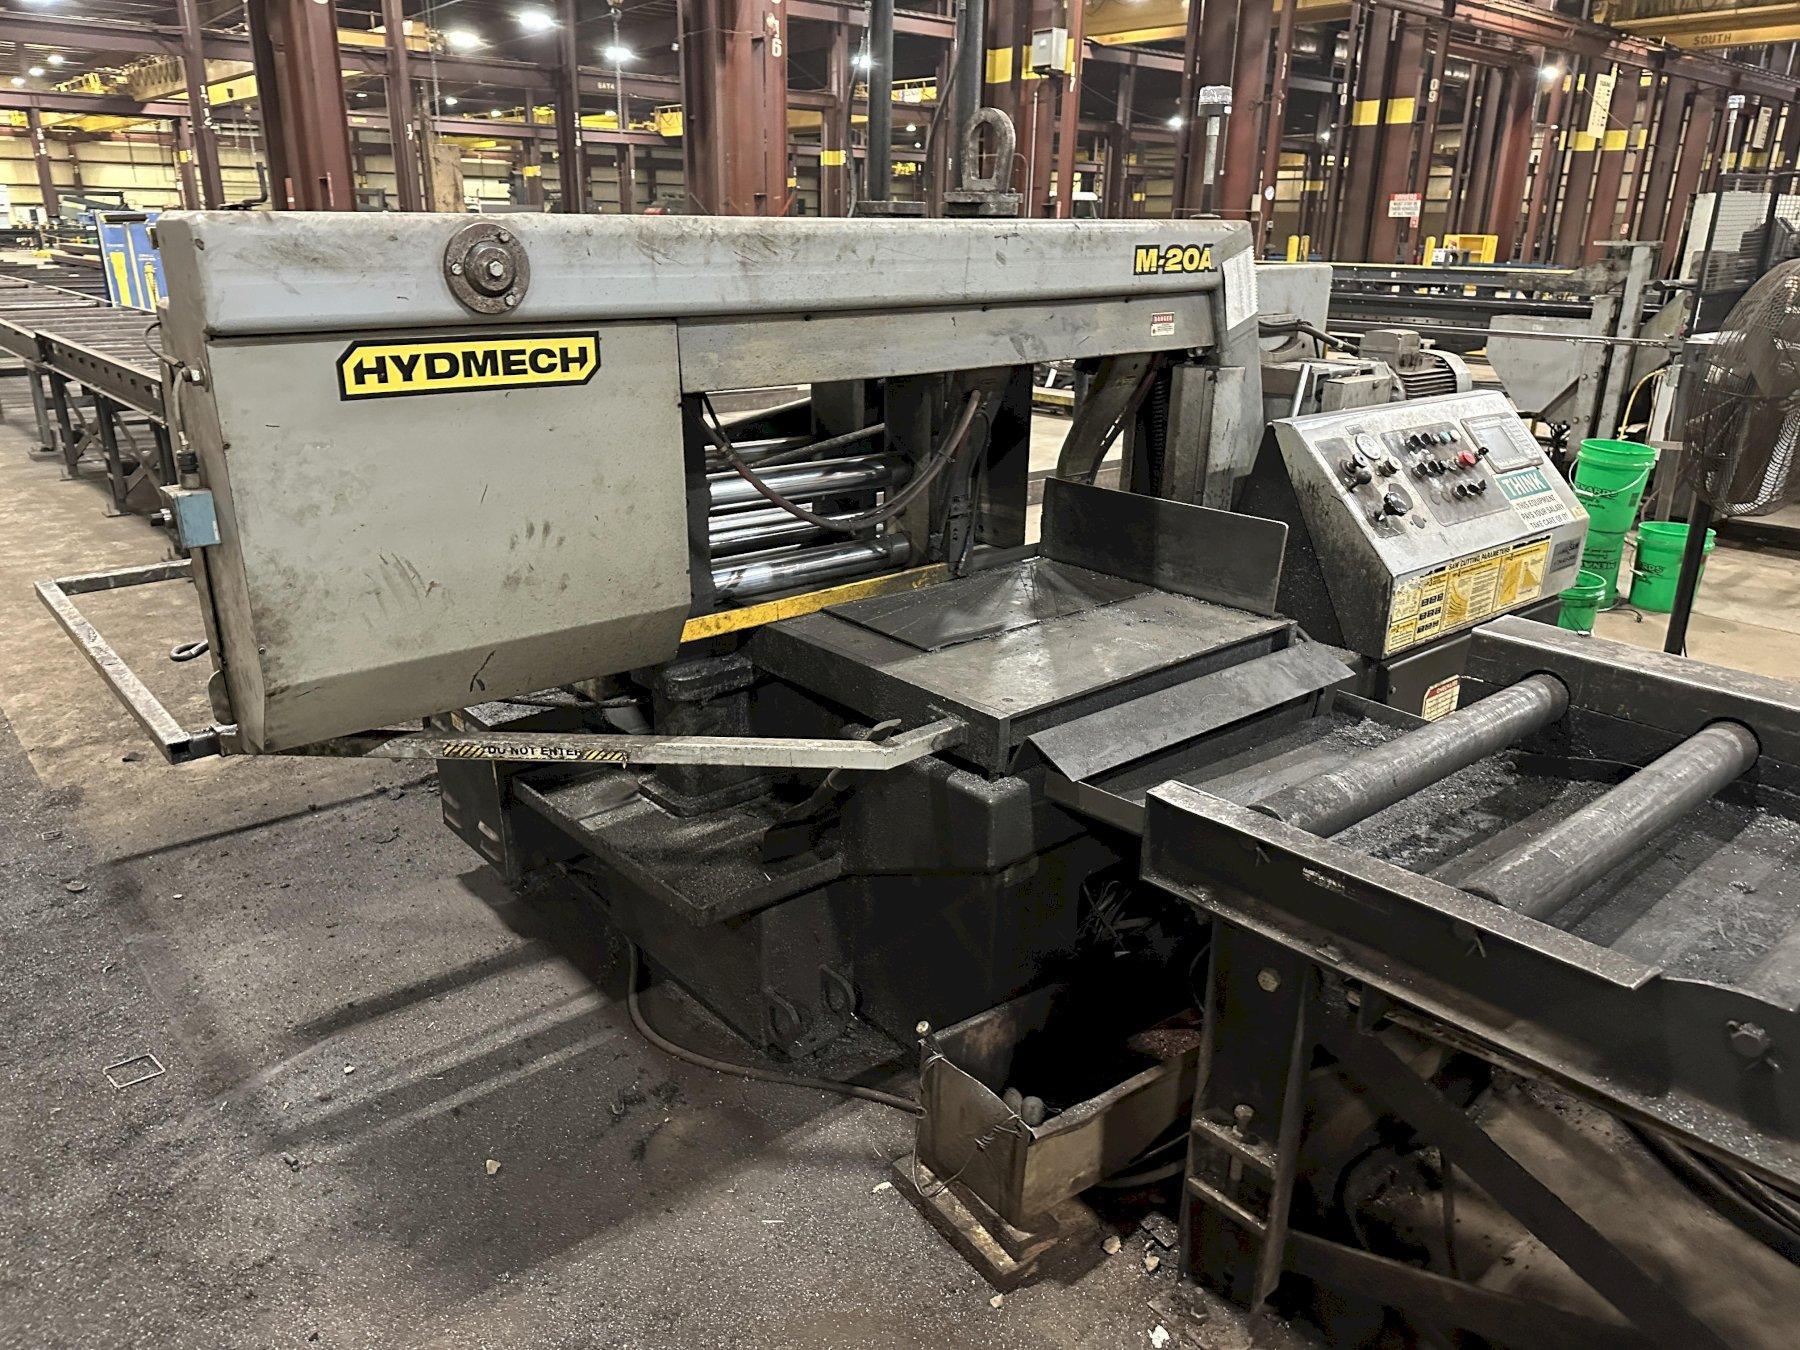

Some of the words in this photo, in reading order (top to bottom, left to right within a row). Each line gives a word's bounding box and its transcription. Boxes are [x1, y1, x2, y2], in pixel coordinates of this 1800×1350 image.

[1693, 33, 1732, 46] SOUTH
[1134, 244, 1217, 275] M-20A
[353, 346, 588, 386] HYDMECH
[1501, 472, 1547, 496] THINK
[1528, 494, 1556, 507] EQUIPMENT
[1521, 511, 1535, 520] PAYS
[1533, 507, 1547, 516] YOUR
[1546, 503, 1565, 513] SALARY
[1530, 520, 1545, 529] TAKE
[1543, 516, 1557, 525] CARE
[1449, 561, 1460, 570] SAW
[1460, 555, 1481, 567] CUTTING
[1480, 545, 1511, 559] PARAMETERS
[509, 746, 536, 756] NOT
